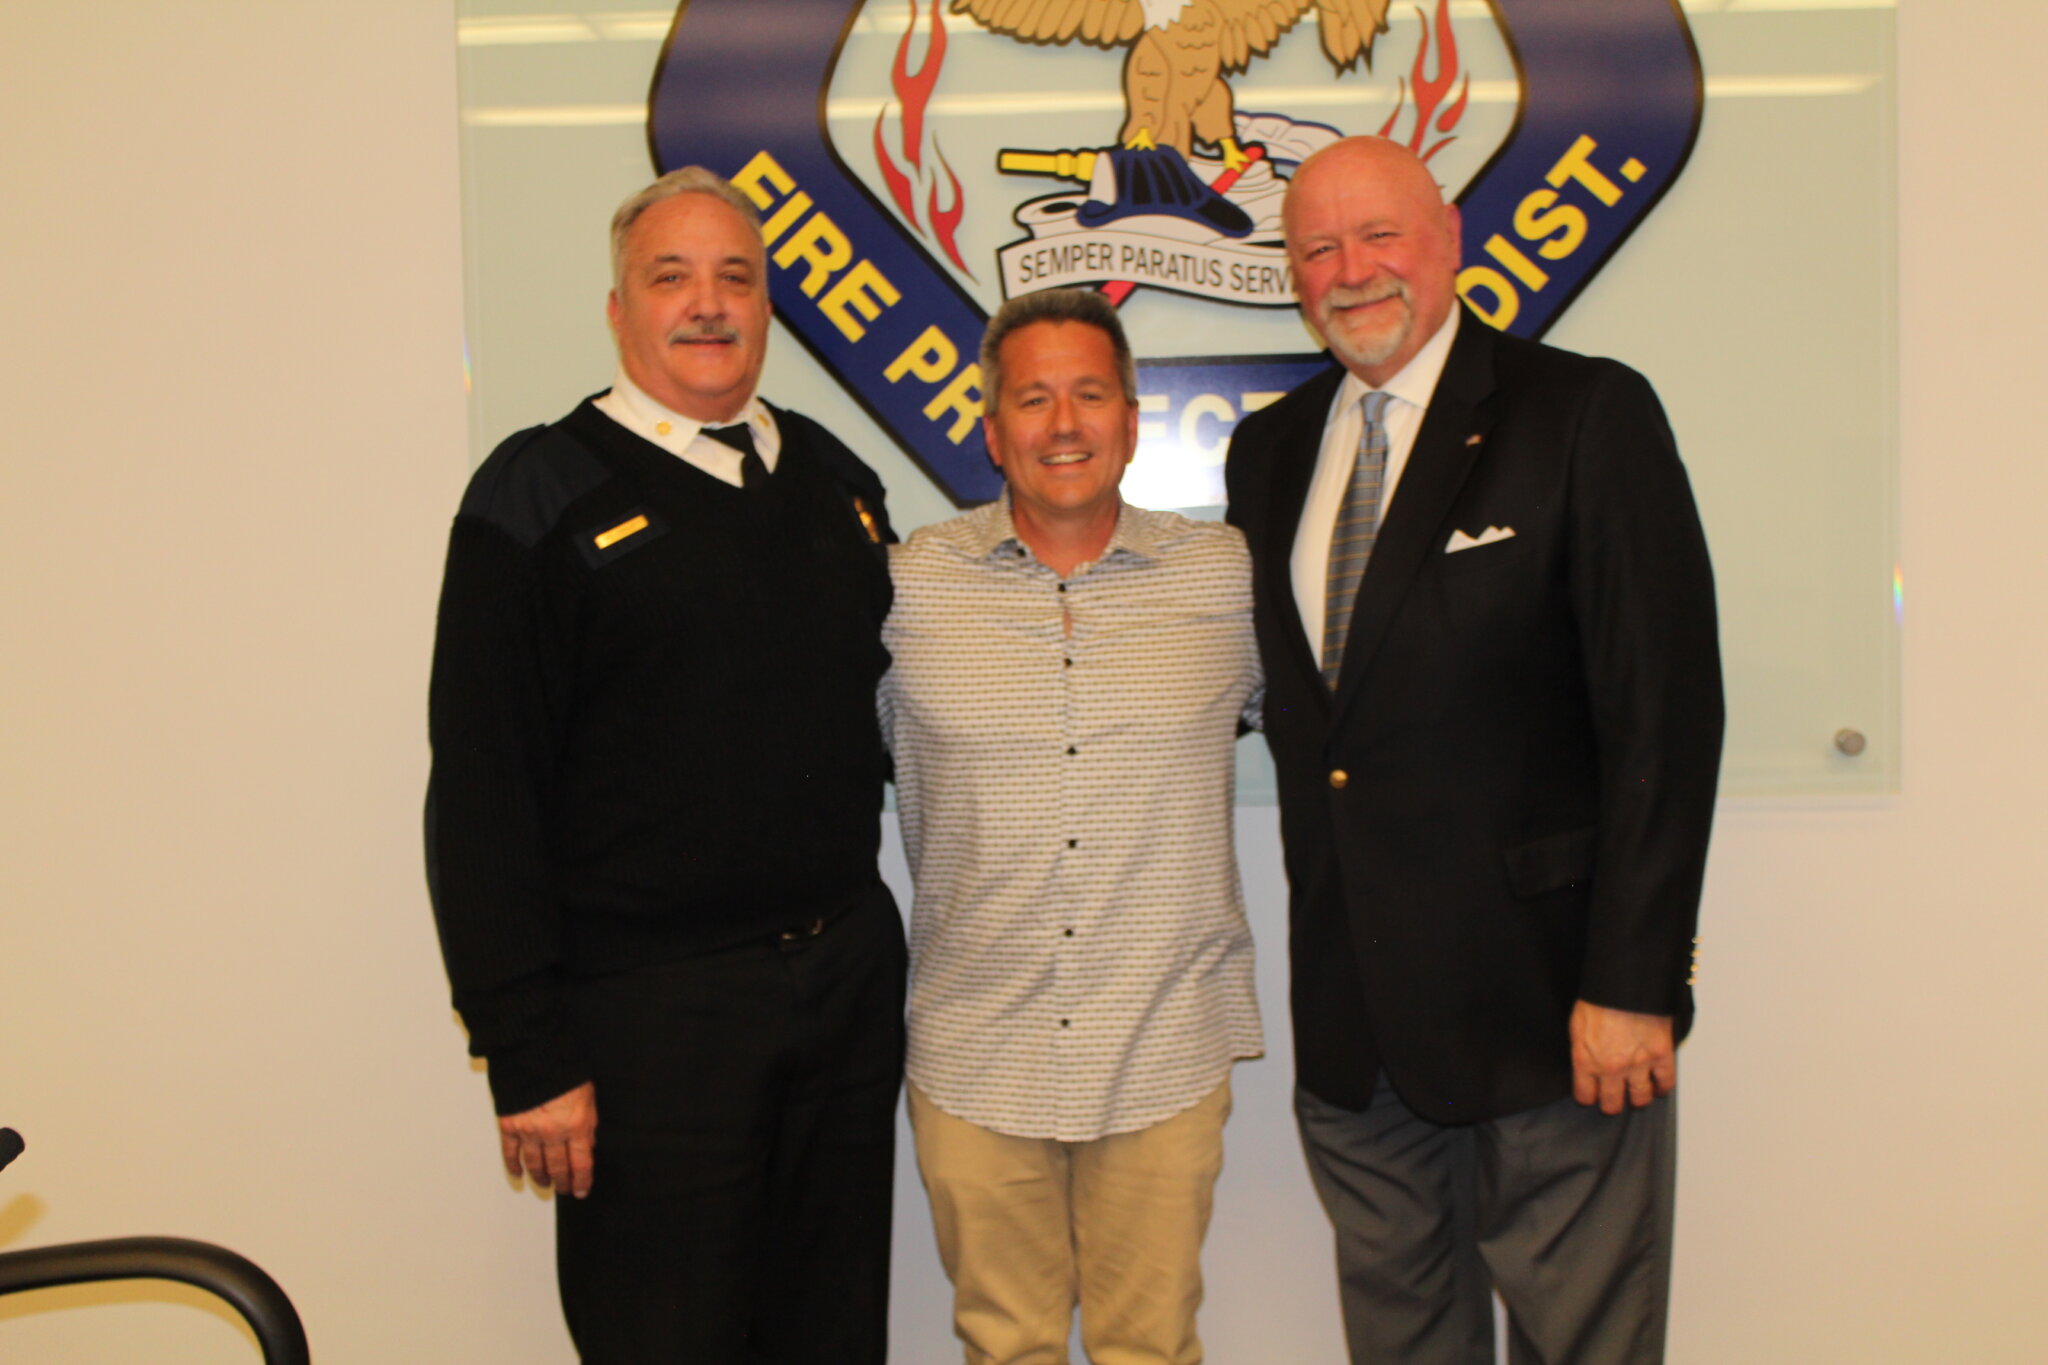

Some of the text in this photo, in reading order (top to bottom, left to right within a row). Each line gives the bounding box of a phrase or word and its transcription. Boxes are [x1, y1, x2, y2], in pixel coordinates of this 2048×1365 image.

[729, 151, 903, 344] FIRE
[1455, 134, 1648, 332] DIST.
[1019, 243, 1296, 295] SEMPER PARATUS SERV
